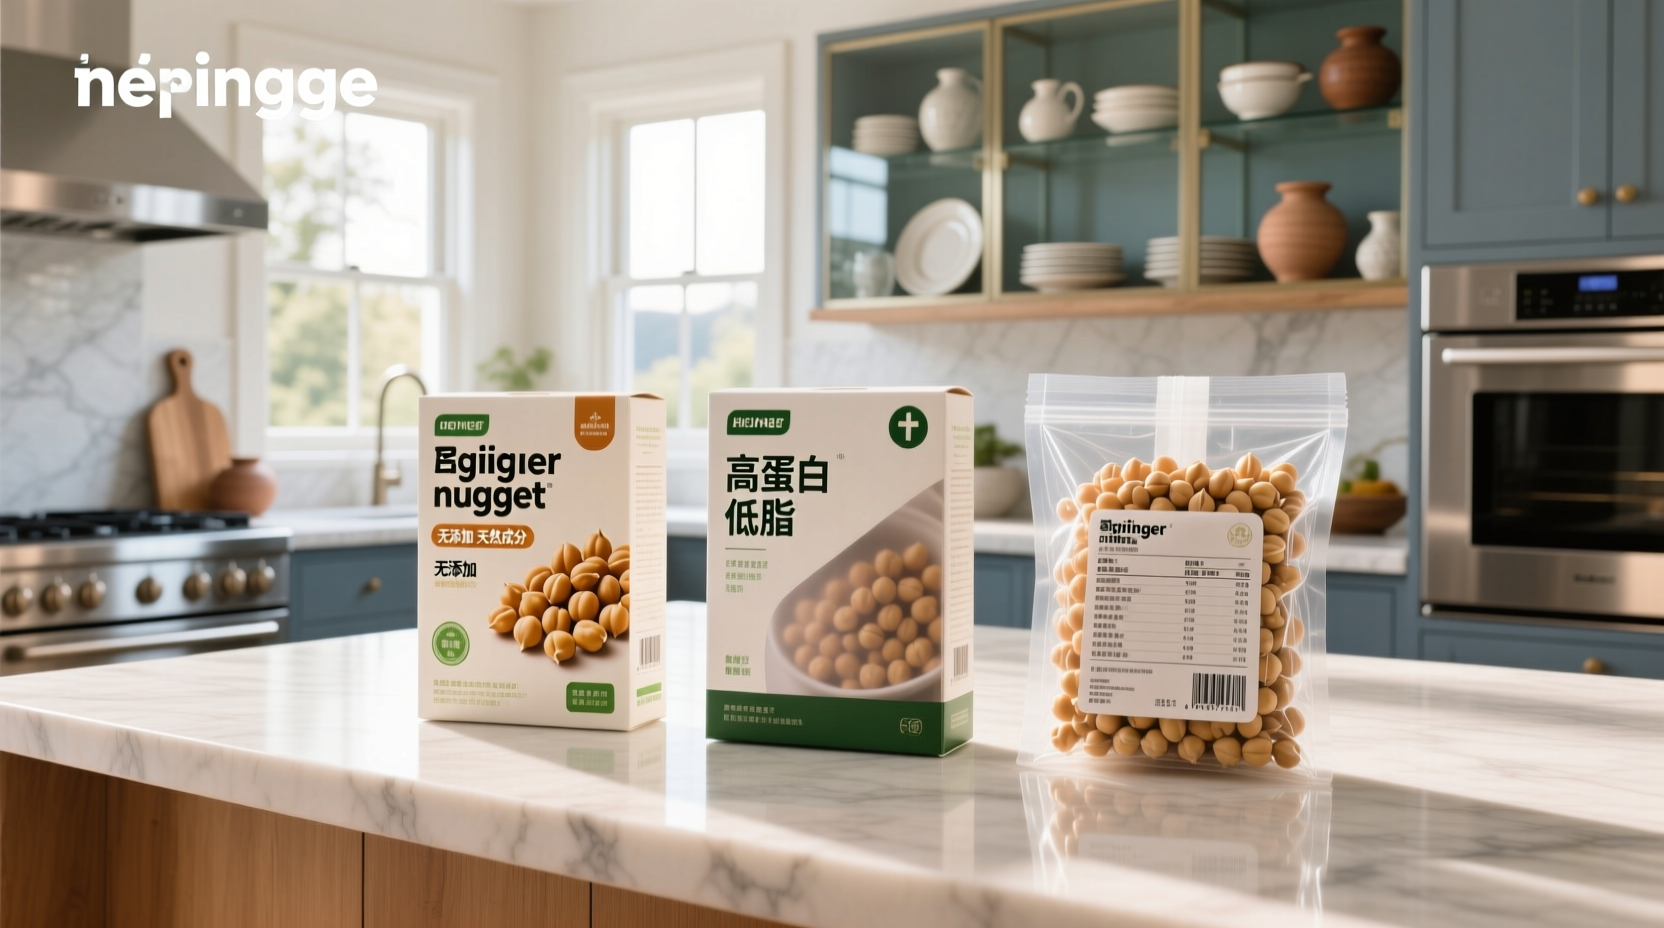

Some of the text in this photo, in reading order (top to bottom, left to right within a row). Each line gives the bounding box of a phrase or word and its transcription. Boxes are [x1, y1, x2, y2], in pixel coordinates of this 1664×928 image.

[726, 454, 828, 493] 高蛋白
[434, 482, 546, 517] nugget
[725, 498, 796, 537] 低脂
[434, 560, 477, 578] 无添加
